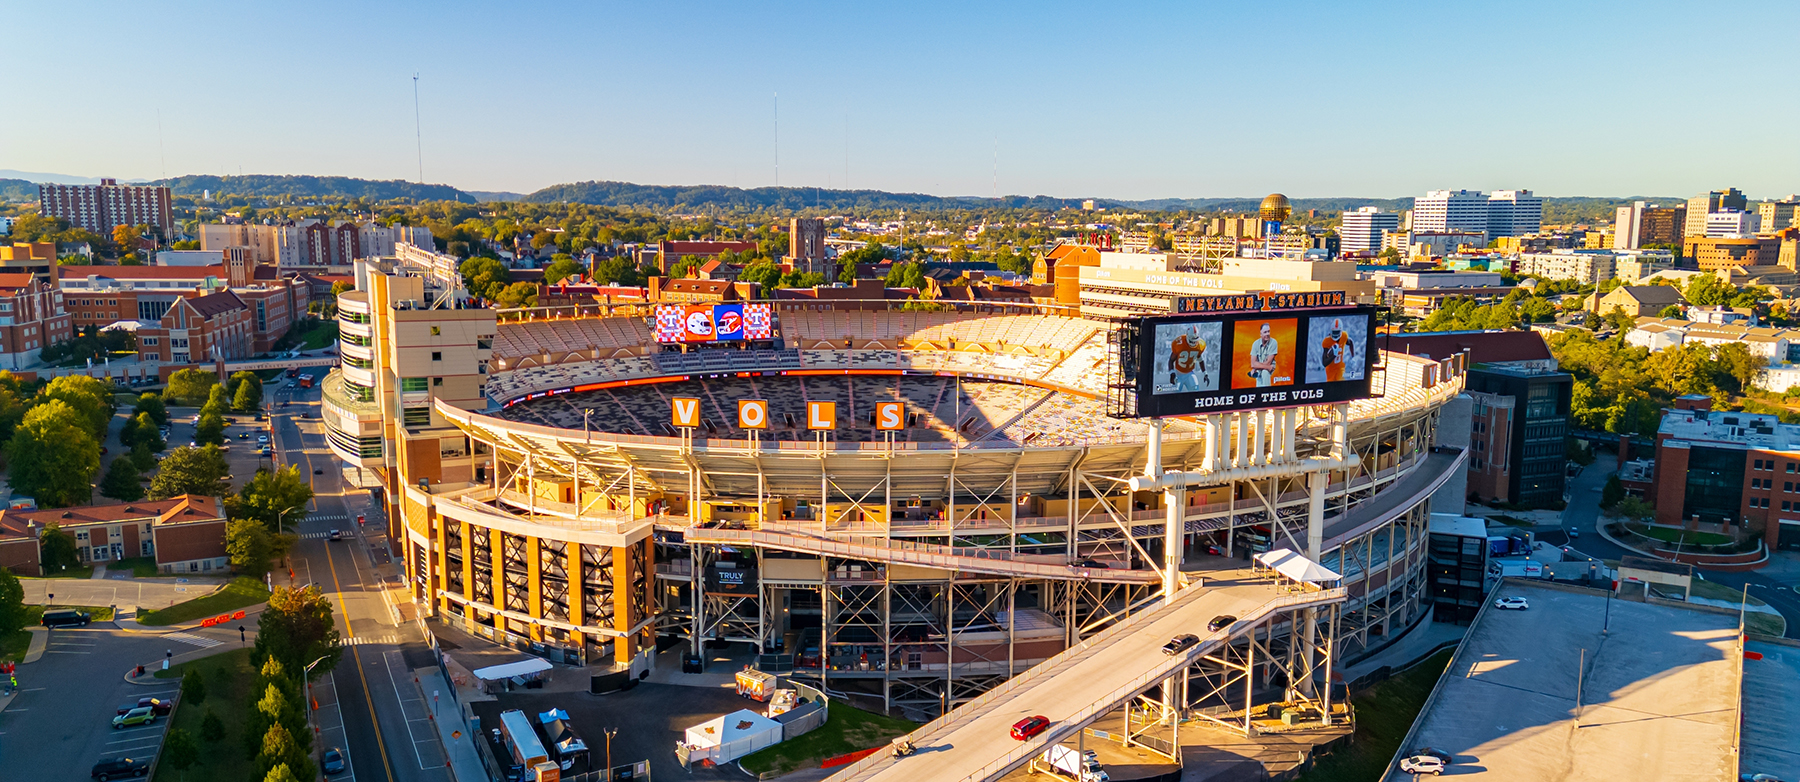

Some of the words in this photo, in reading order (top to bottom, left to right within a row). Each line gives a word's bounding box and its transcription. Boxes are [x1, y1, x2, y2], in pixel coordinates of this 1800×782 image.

[1146, 275, 1167, 284] HOME
[1170, 276, 1180, 285] OF
[1183, 277, 1198, 287] THE
[1201, 279, 1223, 289] VOLS
[1186, 297, 1254, 311] NEYLAND
[1278, 293, 1342, 307] STADIUM
[1178, 351, 1200, 368] 27
[1194, 395, 1234, 408] HOME
[1239, 393, 1256, 404] OF
[1261, 391, 1287, 402] THE
[1292, 389, 1324, 400] VOLS
[718, 571, 744, 580] TRULY
